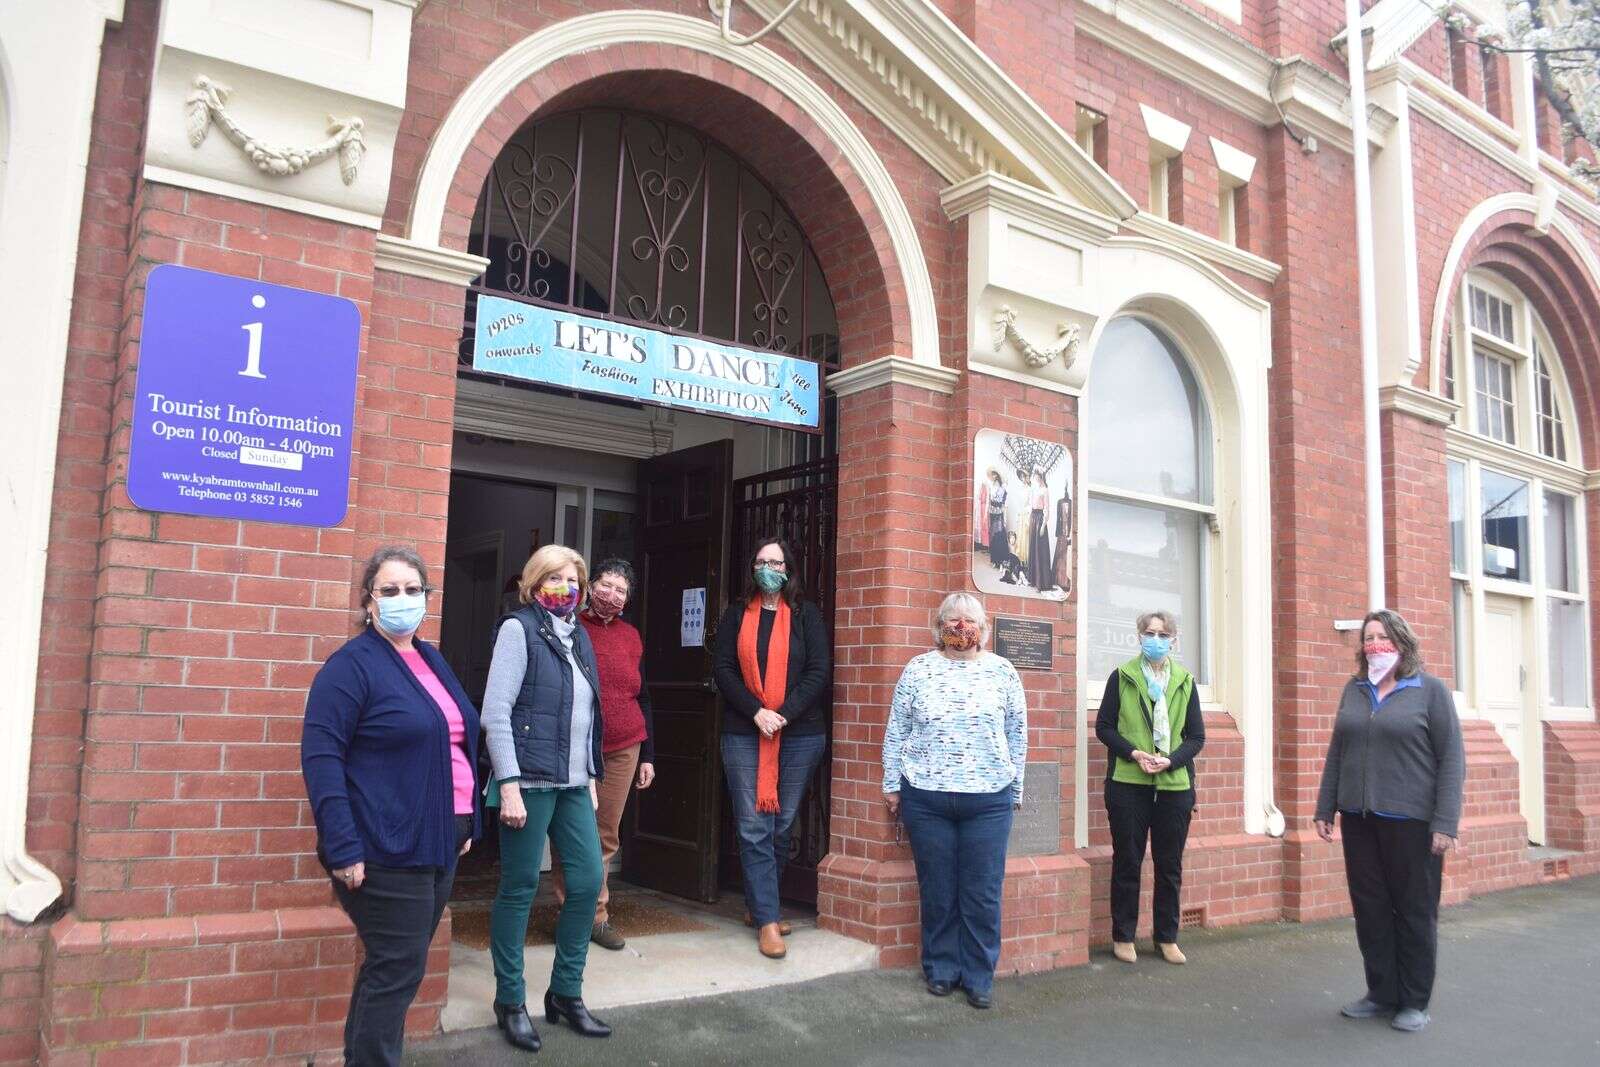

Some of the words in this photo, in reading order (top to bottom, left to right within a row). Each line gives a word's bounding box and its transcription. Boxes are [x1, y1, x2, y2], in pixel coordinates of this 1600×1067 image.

[237, 294, 267, 379] i
[487, 312, 524, 338] 1920s
[485, 343, 541, 359] onwards
[553, 319, 647, 364] LET'S
[672, 344, 781, 389] DANCE
[582, 359, 639, 385] Fashion
[652, 378, 771, 413] EXHIBITION
[780, 390, 807, 416] June
[148, 393, 221, 420] Tourist
[227, 404, 342, 437] Information
[152, 420, 195, 440] Open
[201, 427, 265, 448] 10.00am
[279, 437, 334, 458] 4.00pm
[201, 446, 237, 460] Closed
[248, 450, 289, 467] Sunday
[161, 472, 319, 496] www.kyabramtownhall.com.au
[178, 485, 232, 500] Telephone
[234, 492, 247, 502] 03
[250, 493, 275, 505] 5852
[279, 496, 303, 509] 1546
